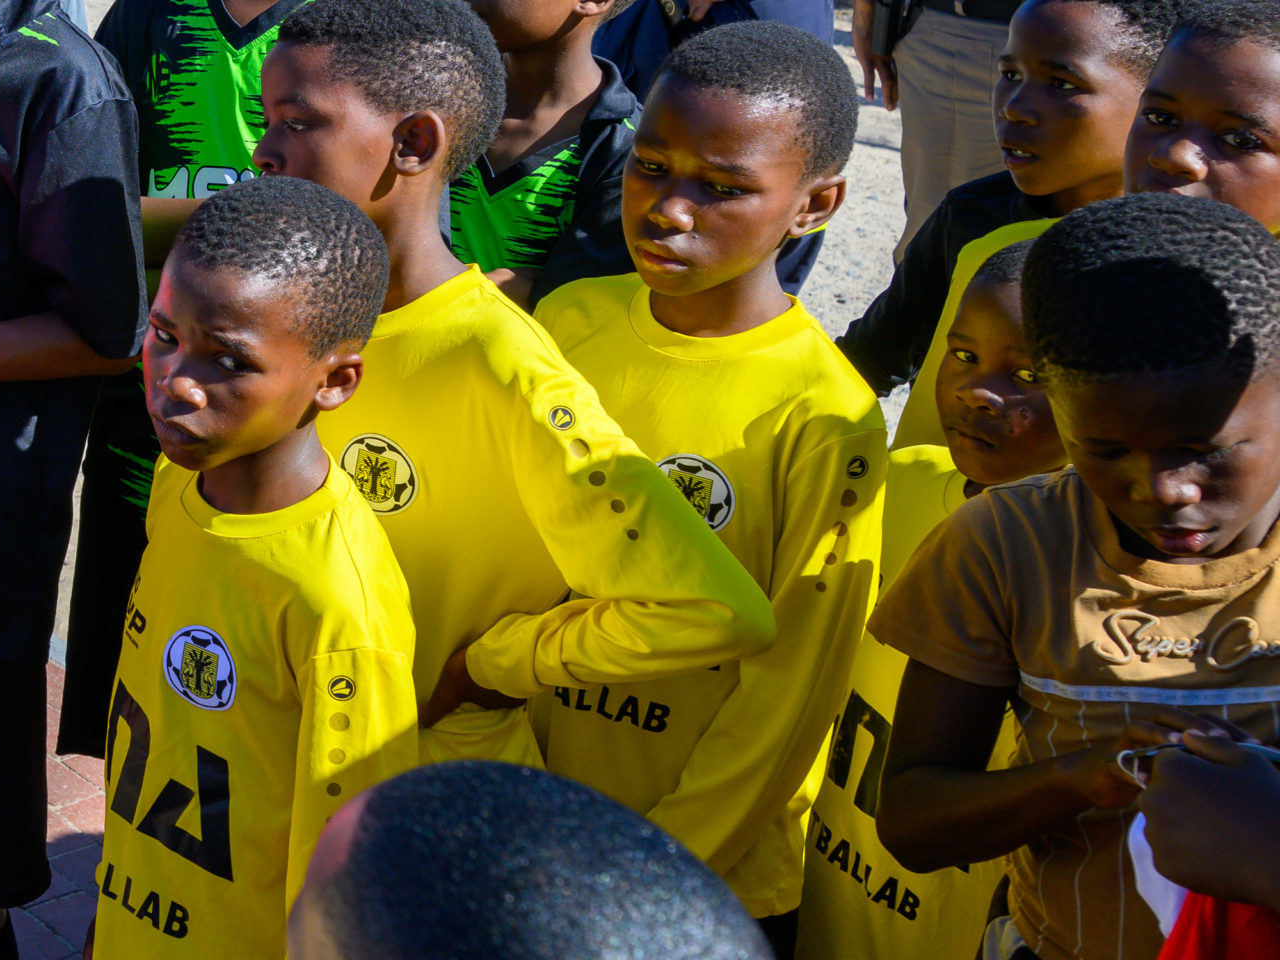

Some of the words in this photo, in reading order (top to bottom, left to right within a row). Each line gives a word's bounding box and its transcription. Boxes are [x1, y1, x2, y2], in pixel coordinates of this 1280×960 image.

[1093, 609, 1202, 664] Super
[554, 685, 670, 733] ALLAB
[101, 862, 190, 939] LLAB
